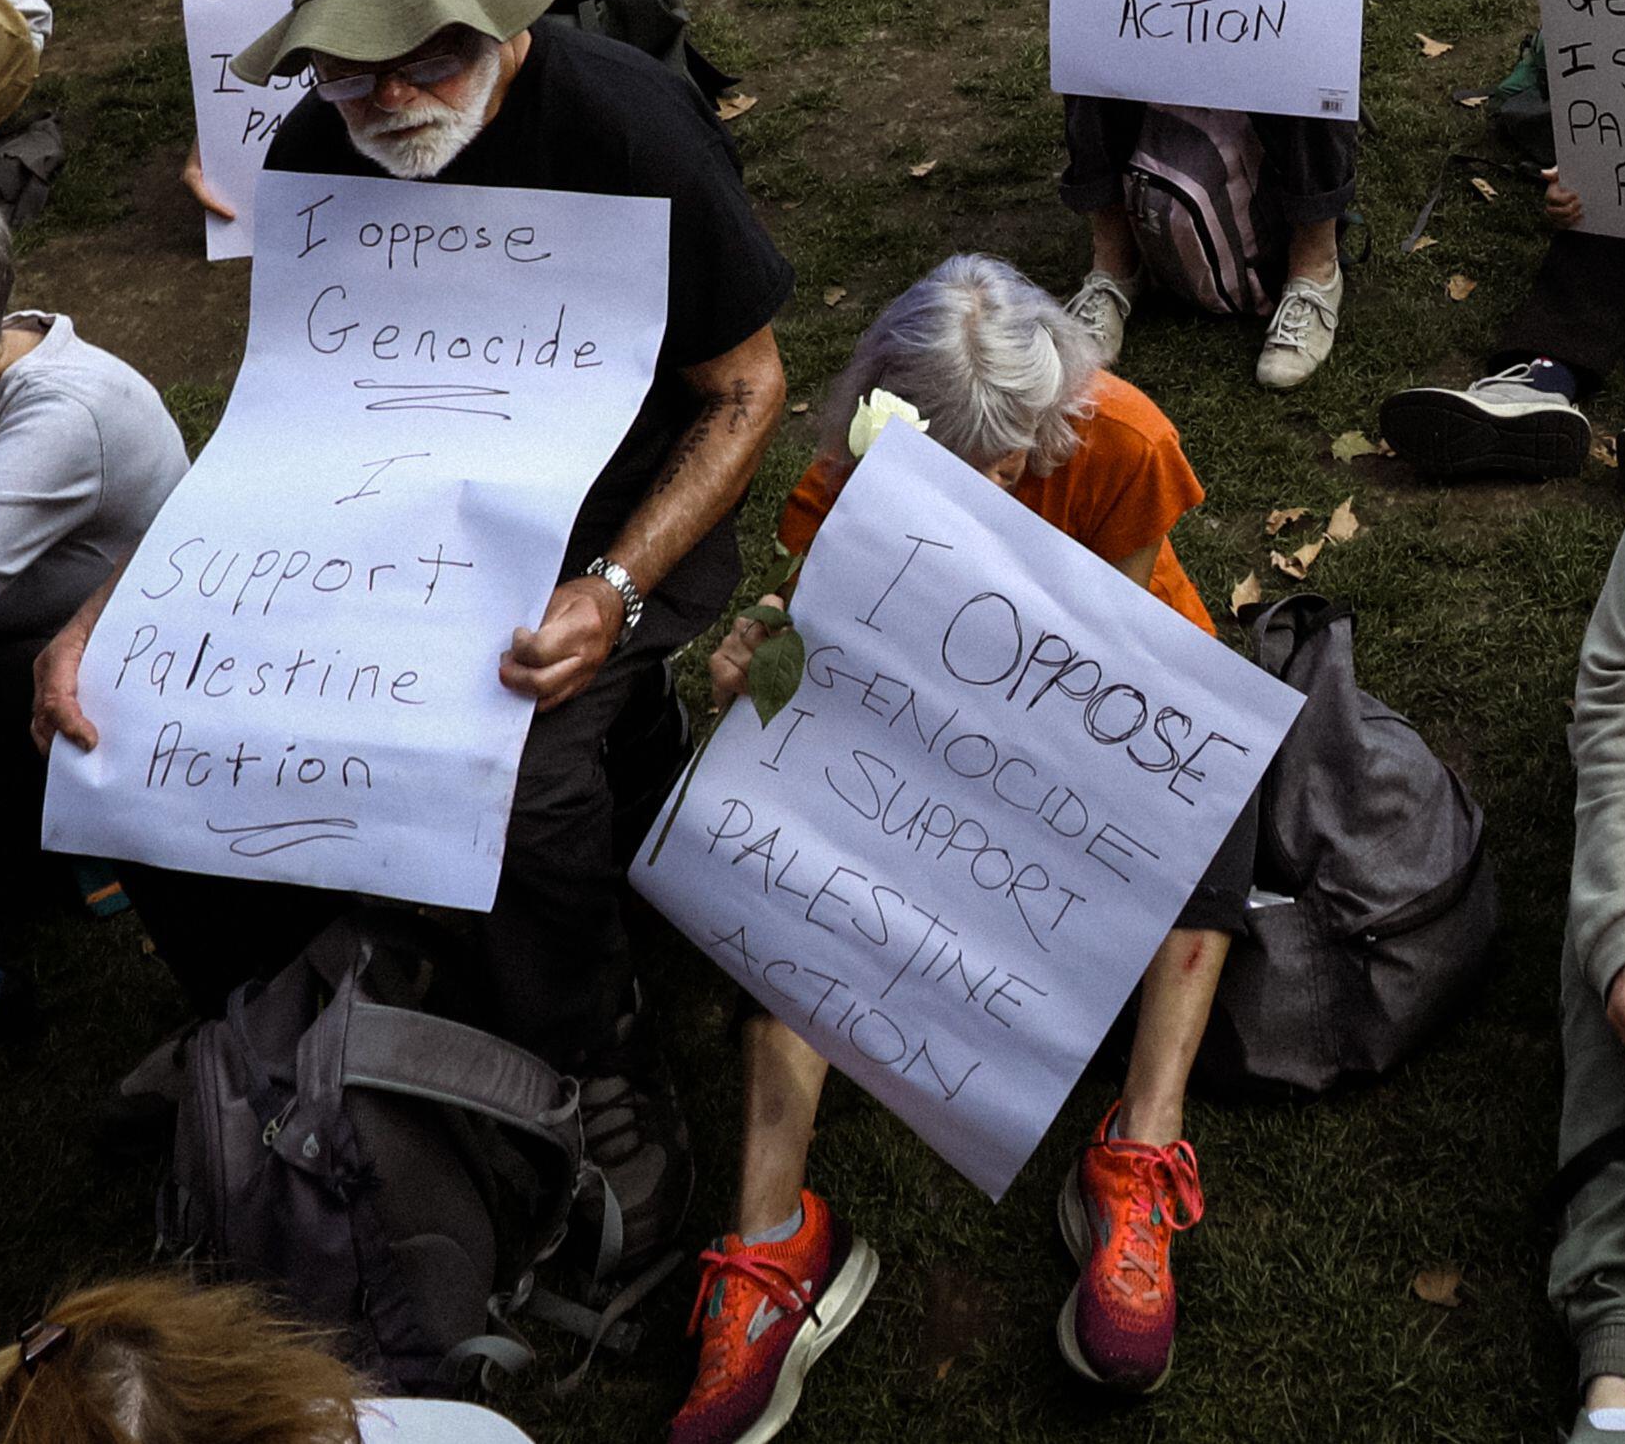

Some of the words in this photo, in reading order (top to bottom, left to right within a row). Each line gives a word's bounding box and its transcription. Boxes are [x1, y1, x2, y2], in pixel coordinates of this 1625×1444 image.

[309, 287, 607, 376] Genocide
[356, 220, 554, 273] oppose
[114, 627, 427, 709] Palestine
[941, 589, 1253, 804] OPPOSE
[145, 722, 376, 794] Action
[804, 641, 1161, 883] GENOCIDE
[705, 798, 1049, 1030] PALESTINE
[825, 748, 1087, 952] SUPPORT
[708, 924, 982, 1103] ACTION
